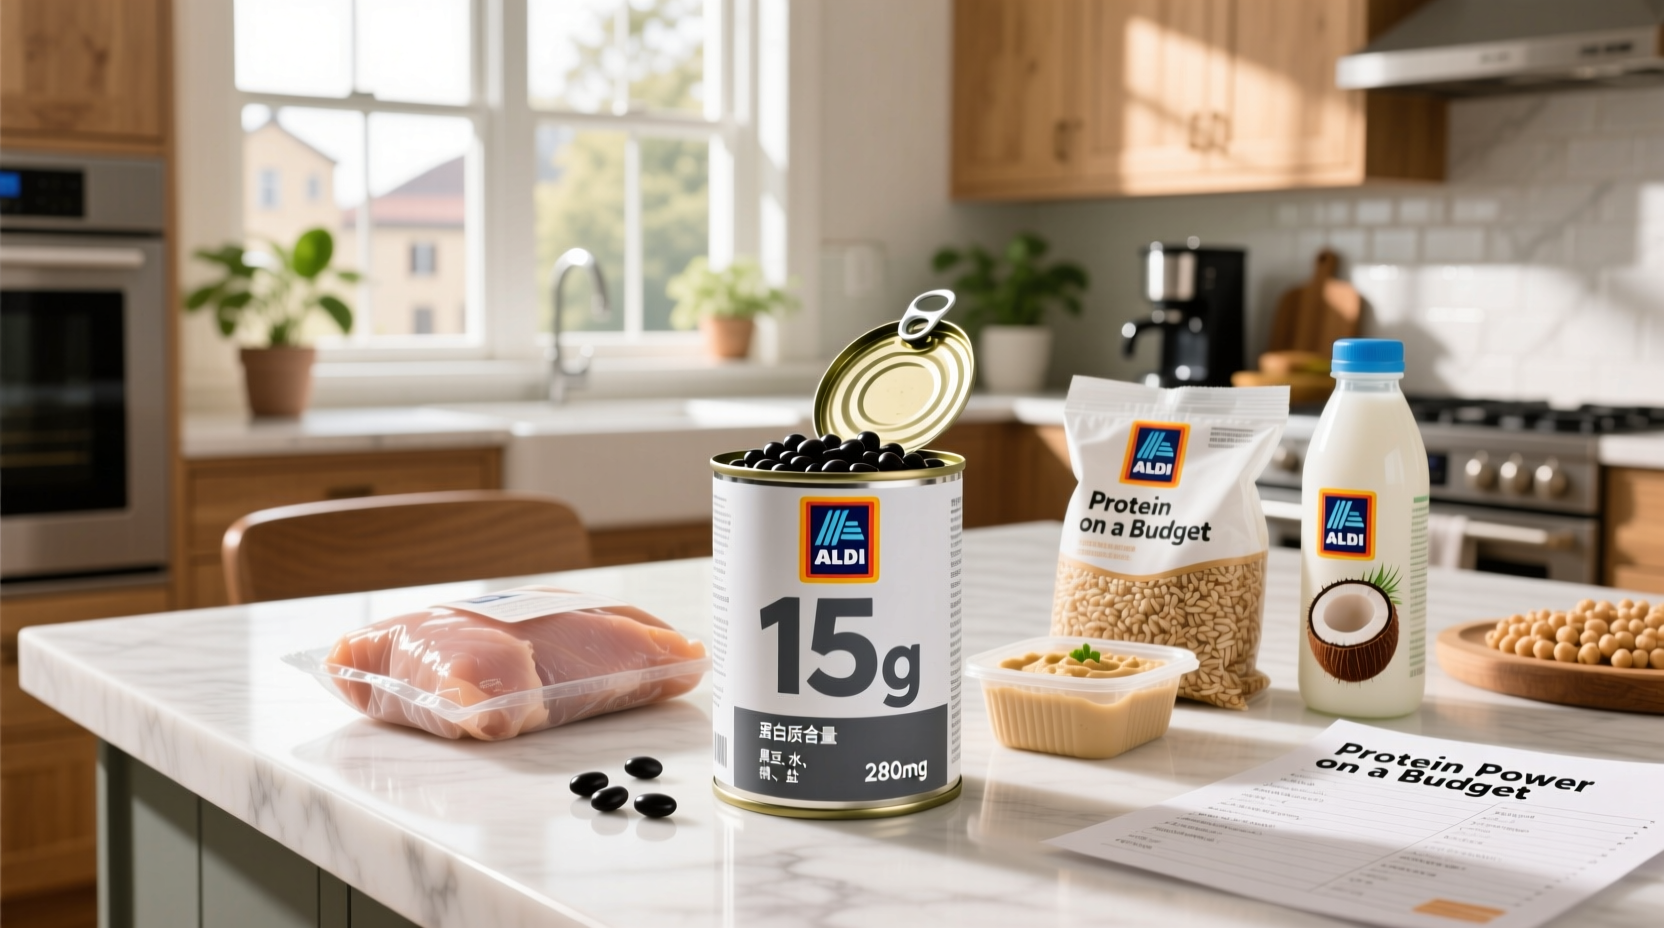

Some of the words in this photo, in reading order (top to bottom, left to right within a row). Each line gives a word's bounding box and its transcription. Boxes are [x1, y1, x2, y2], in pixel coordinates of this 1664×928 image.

[1132, 461, 1173, 476] ALDI
[1088, 490, 1171, 516] Protein
[1079, 517, 1106, 534] on
[1111, 521, 1125, 537] a
[1129, 519, 1212, 545] Budget
[1325, 531, 1364, 547] ALDI
[814, 549, 865, 565] ALDI
[760, 596, 920, 708] 15g
[864, 760, 928, 782] 280mg
[1315, 758, 1360, 774] on
[1367, 767, 1389, 779] a
[1397, 769, 1531, 800] Budget
[1334, 742, 1463, 774] Protein
[1475, 763, 1595, 793] Power
